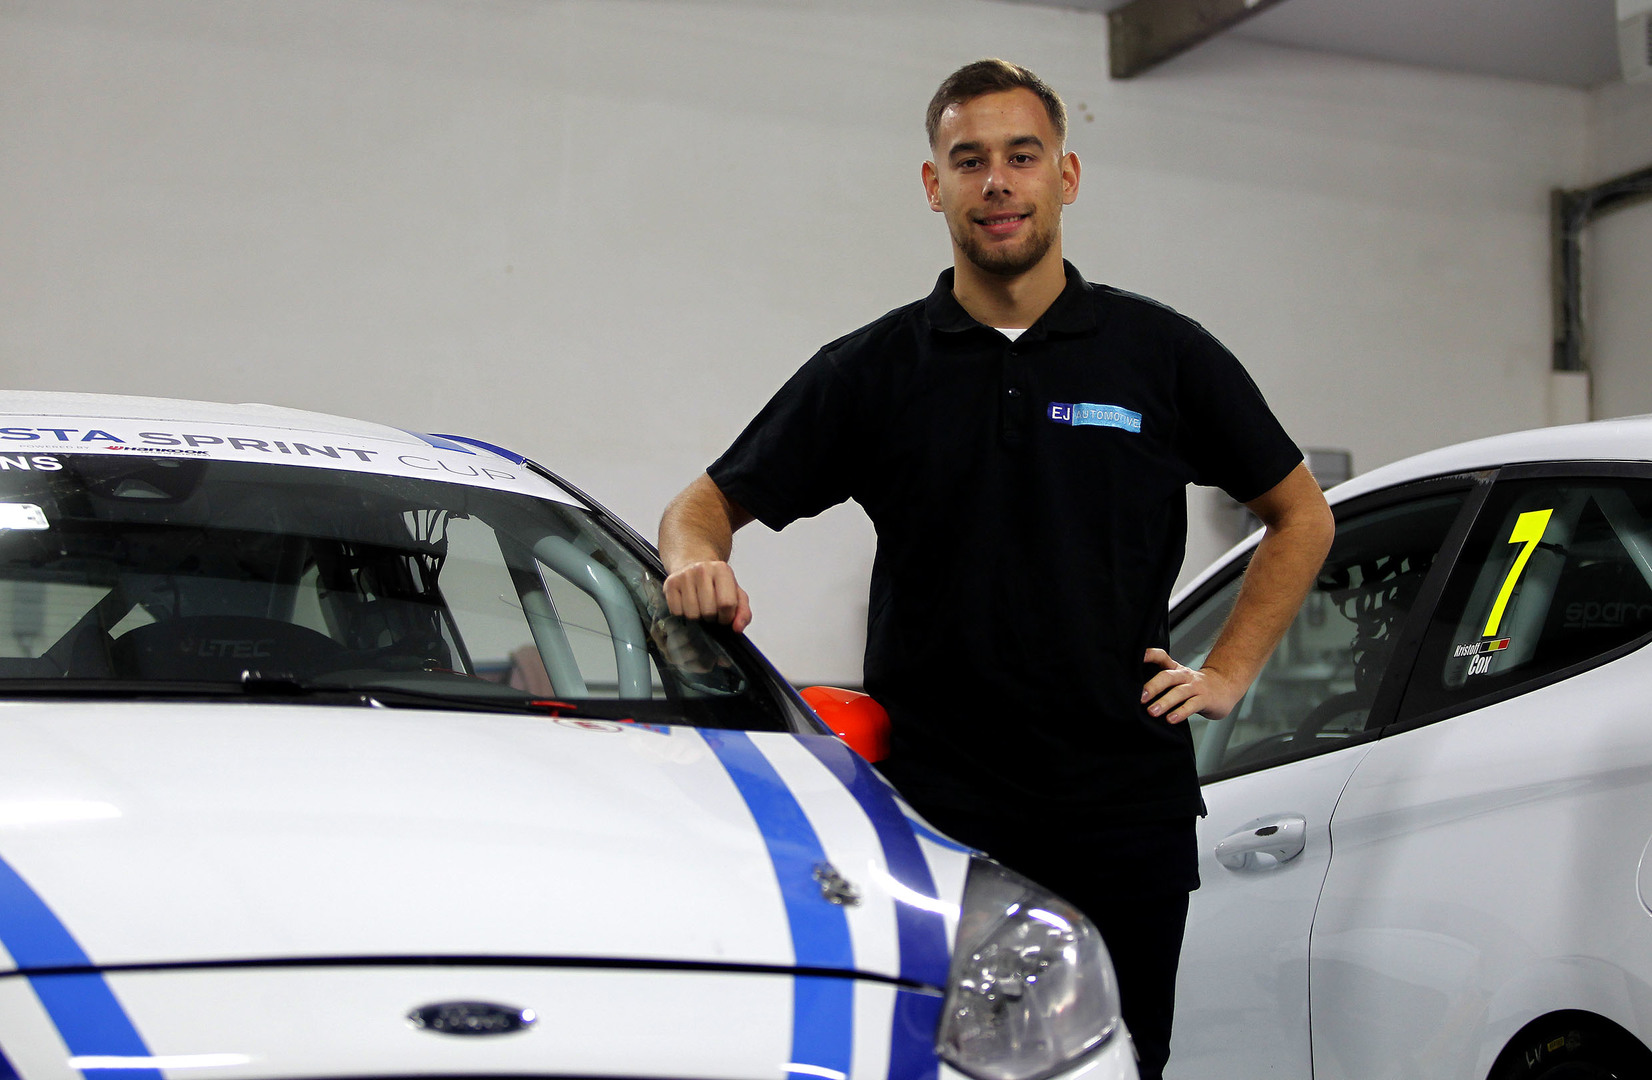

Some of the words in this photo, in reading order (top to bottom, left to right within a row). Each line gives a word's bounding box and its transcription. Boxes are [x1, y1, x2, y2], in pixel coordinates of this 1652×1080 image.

[1051, 406, 1071, 421] EJ
[1075, 409, 1141, 429] AUTOMOTIVE
[138, 431, 379, 462] SPRINT
[398, 455, 516, 480] CUP
[1482, 508, 1554, 637] 7
[1453, 642, 1481, 658] Kristoff
